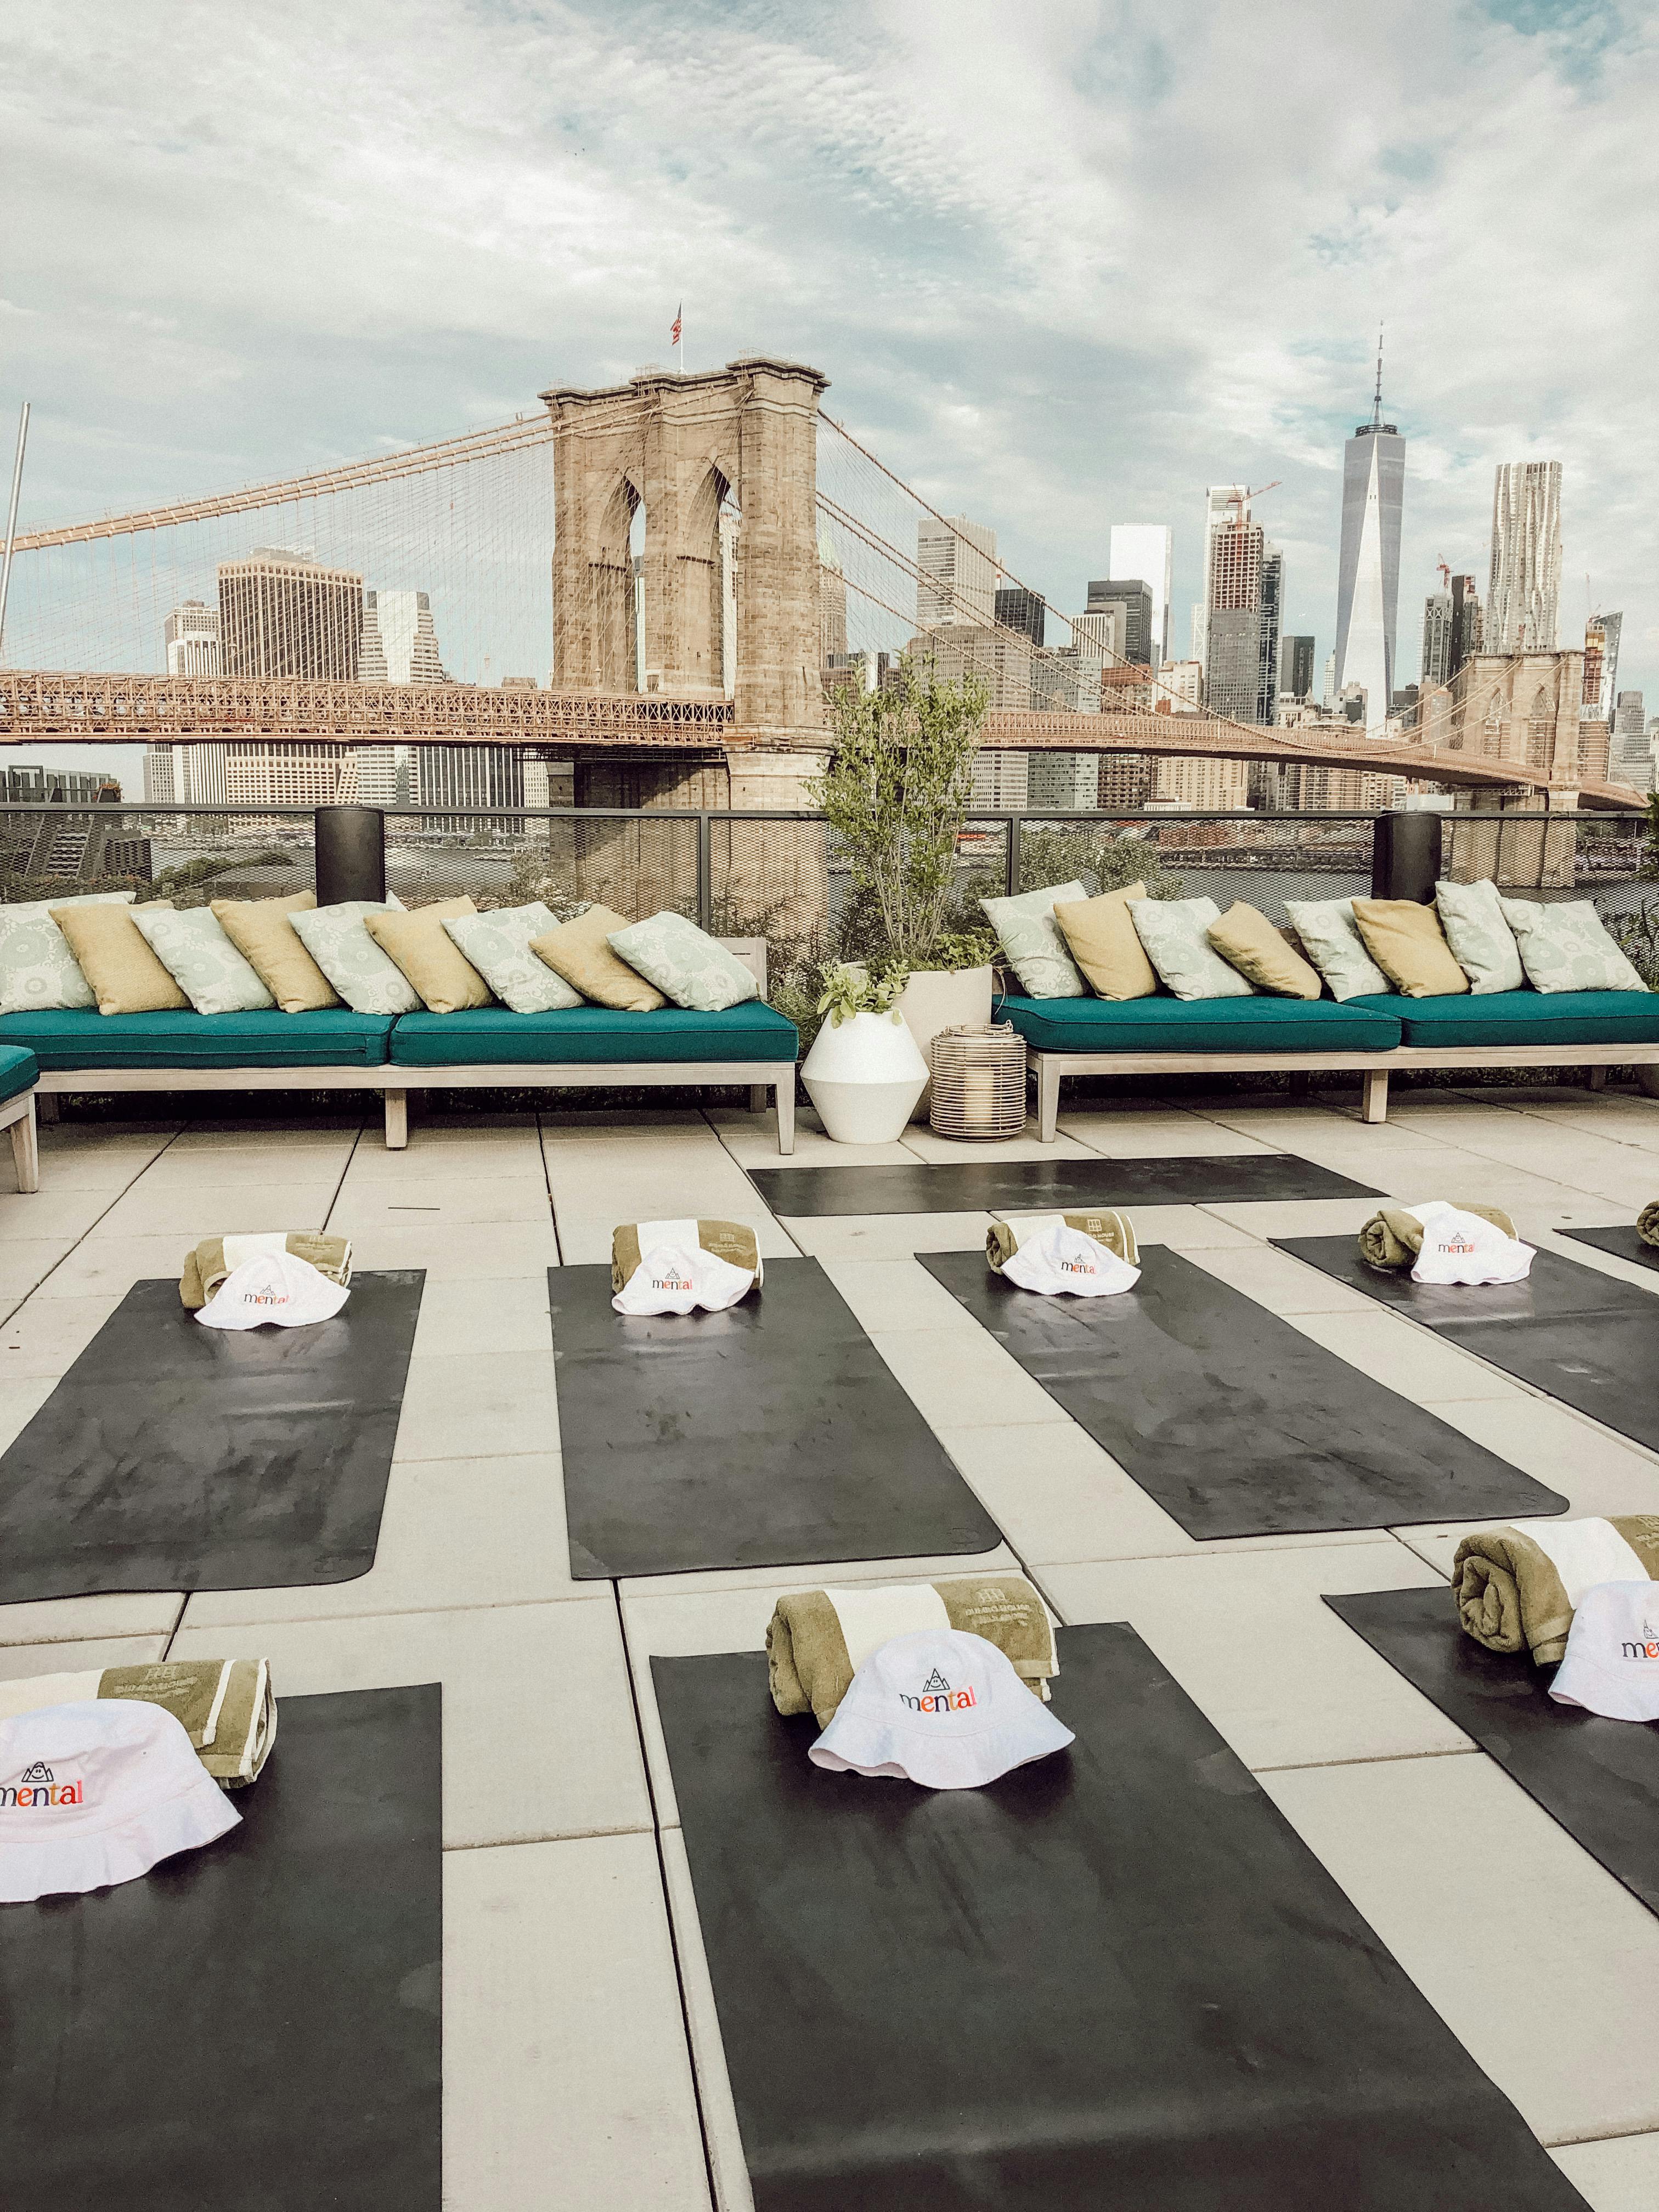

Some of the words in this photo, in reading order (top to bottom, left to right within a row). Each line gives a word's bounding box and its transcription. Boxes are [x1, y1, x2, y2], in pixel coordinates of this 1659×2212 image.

[1061, 1262, 1096, 1274] menta
[652, 1279, 692, 1290] mental
[244, 1294, 290, 1304] mental
[1622, 1642, 1659, 1658] me
[899, 1685, 977, 1712] mental
[0, 1780, 83, 1807] mental
